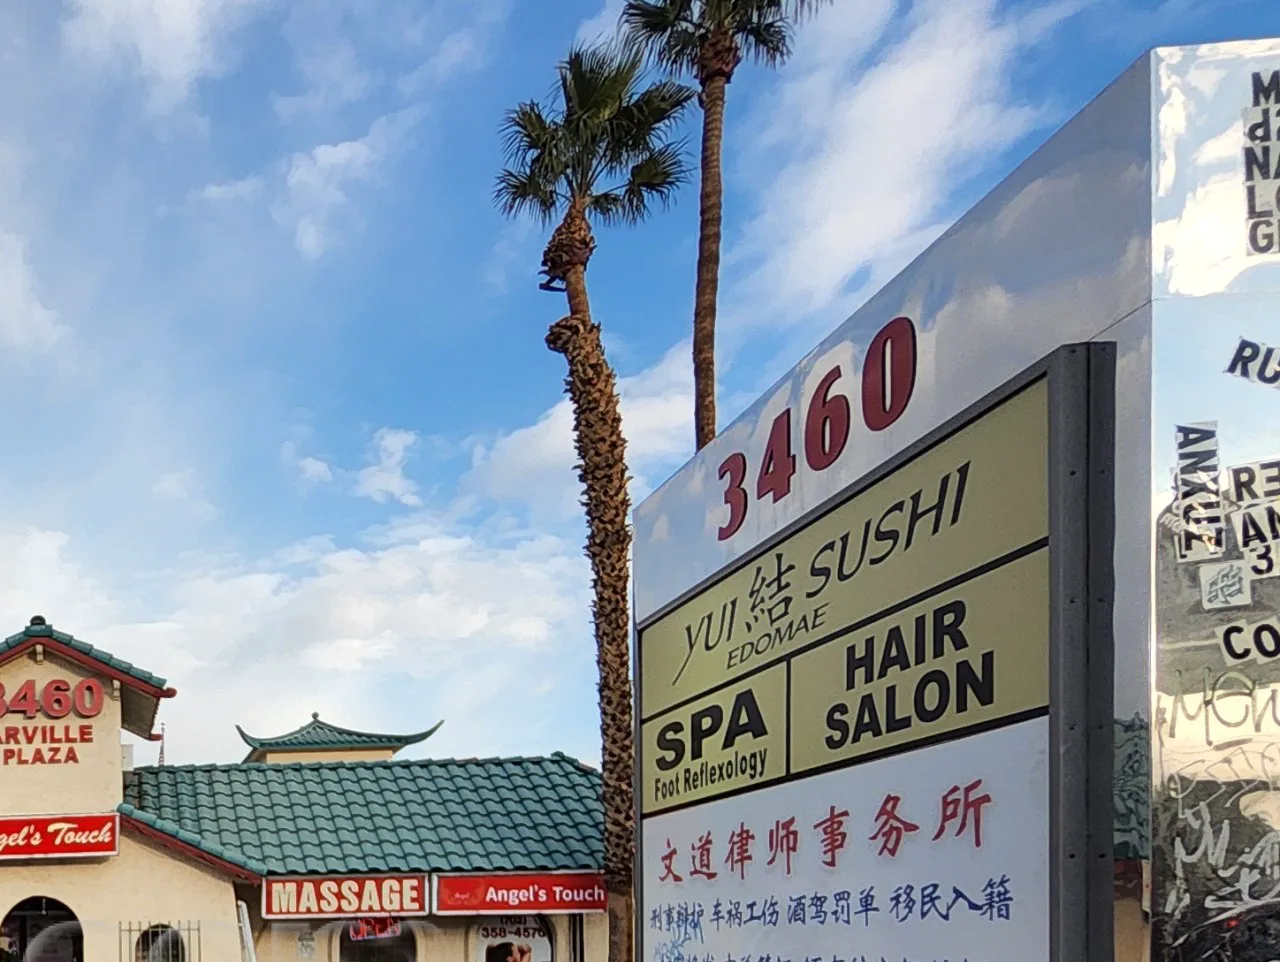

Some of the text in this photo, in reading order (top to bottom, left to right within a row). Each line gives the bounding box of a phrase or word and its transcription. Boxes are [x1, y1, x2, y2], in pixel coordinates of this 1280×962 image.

[1246, 185, 1280, 219] L
[1249, 219, 1280, 253] G
[717, 316, 918, 541] 3460
[672, 460, 972, 686] YUI 結 SUSHI
[726, 603, 830, 670] EDOMAE
[845, 600, 969, 692] HAIR
[656, 688, 768, 772] SPA
[824, 651, 995, 750] SALON
[3, 747, 79, 765] PLAZA
[654, 748, 768, 802] Foot Reflexology
[47, 822, 112, 845] Touch
[658, 779, 991, 882] 文道律师事务所
[271, 878, 419, 913] MASSAGE
[486, 884, 605, 905] Angel's Touch
